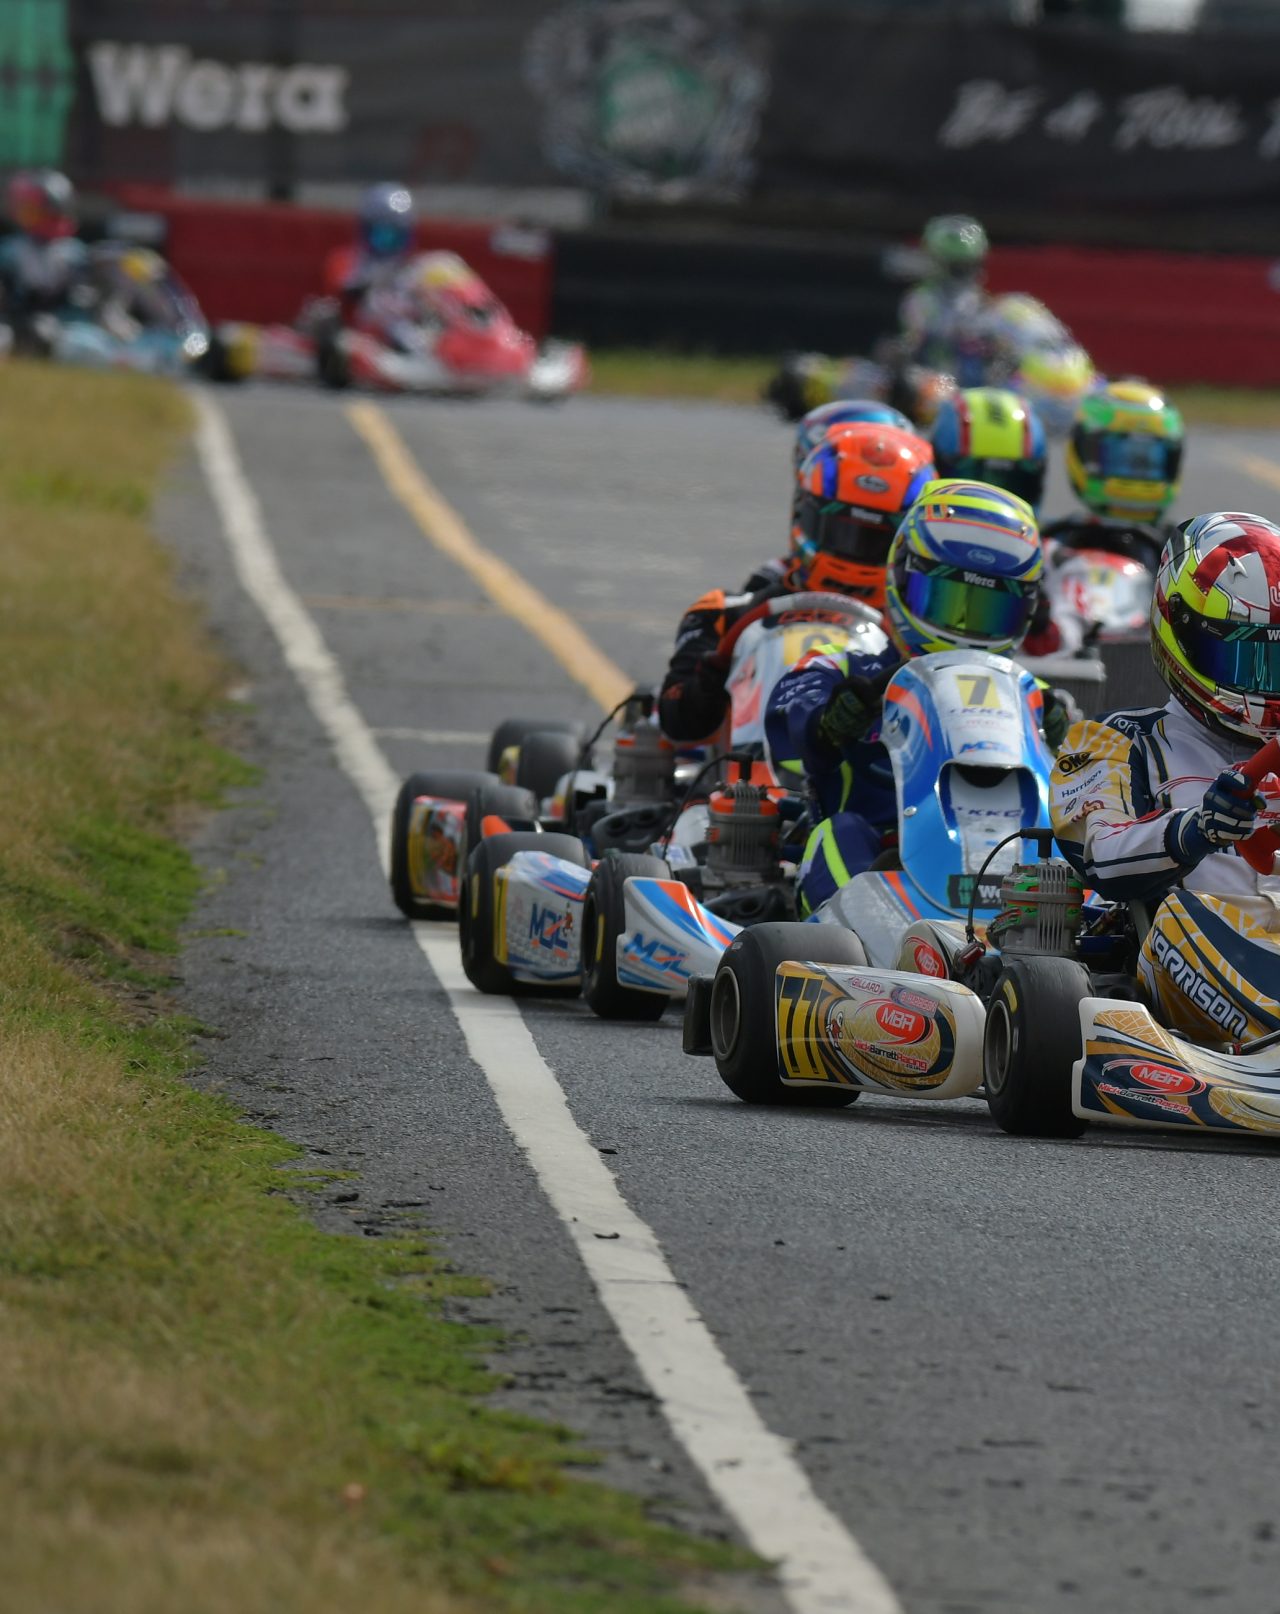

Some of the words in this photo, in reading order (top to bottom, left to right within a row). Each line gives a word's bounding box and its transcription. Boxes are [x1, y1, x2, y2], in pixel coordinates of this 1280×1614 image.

[90, 41, 348, 133] Wera
[963, 572, 996, 588] Wera
[957, 675, 990, 706] 7
[1062, 770, 1102, 798] Harrison
[851, 977, 881, 994] GILLARD
[782, 976, 823, 1074] 77
[881, 1007, 916, 1032] MBR
[1139, 1066, 1184, 1087] MBR
